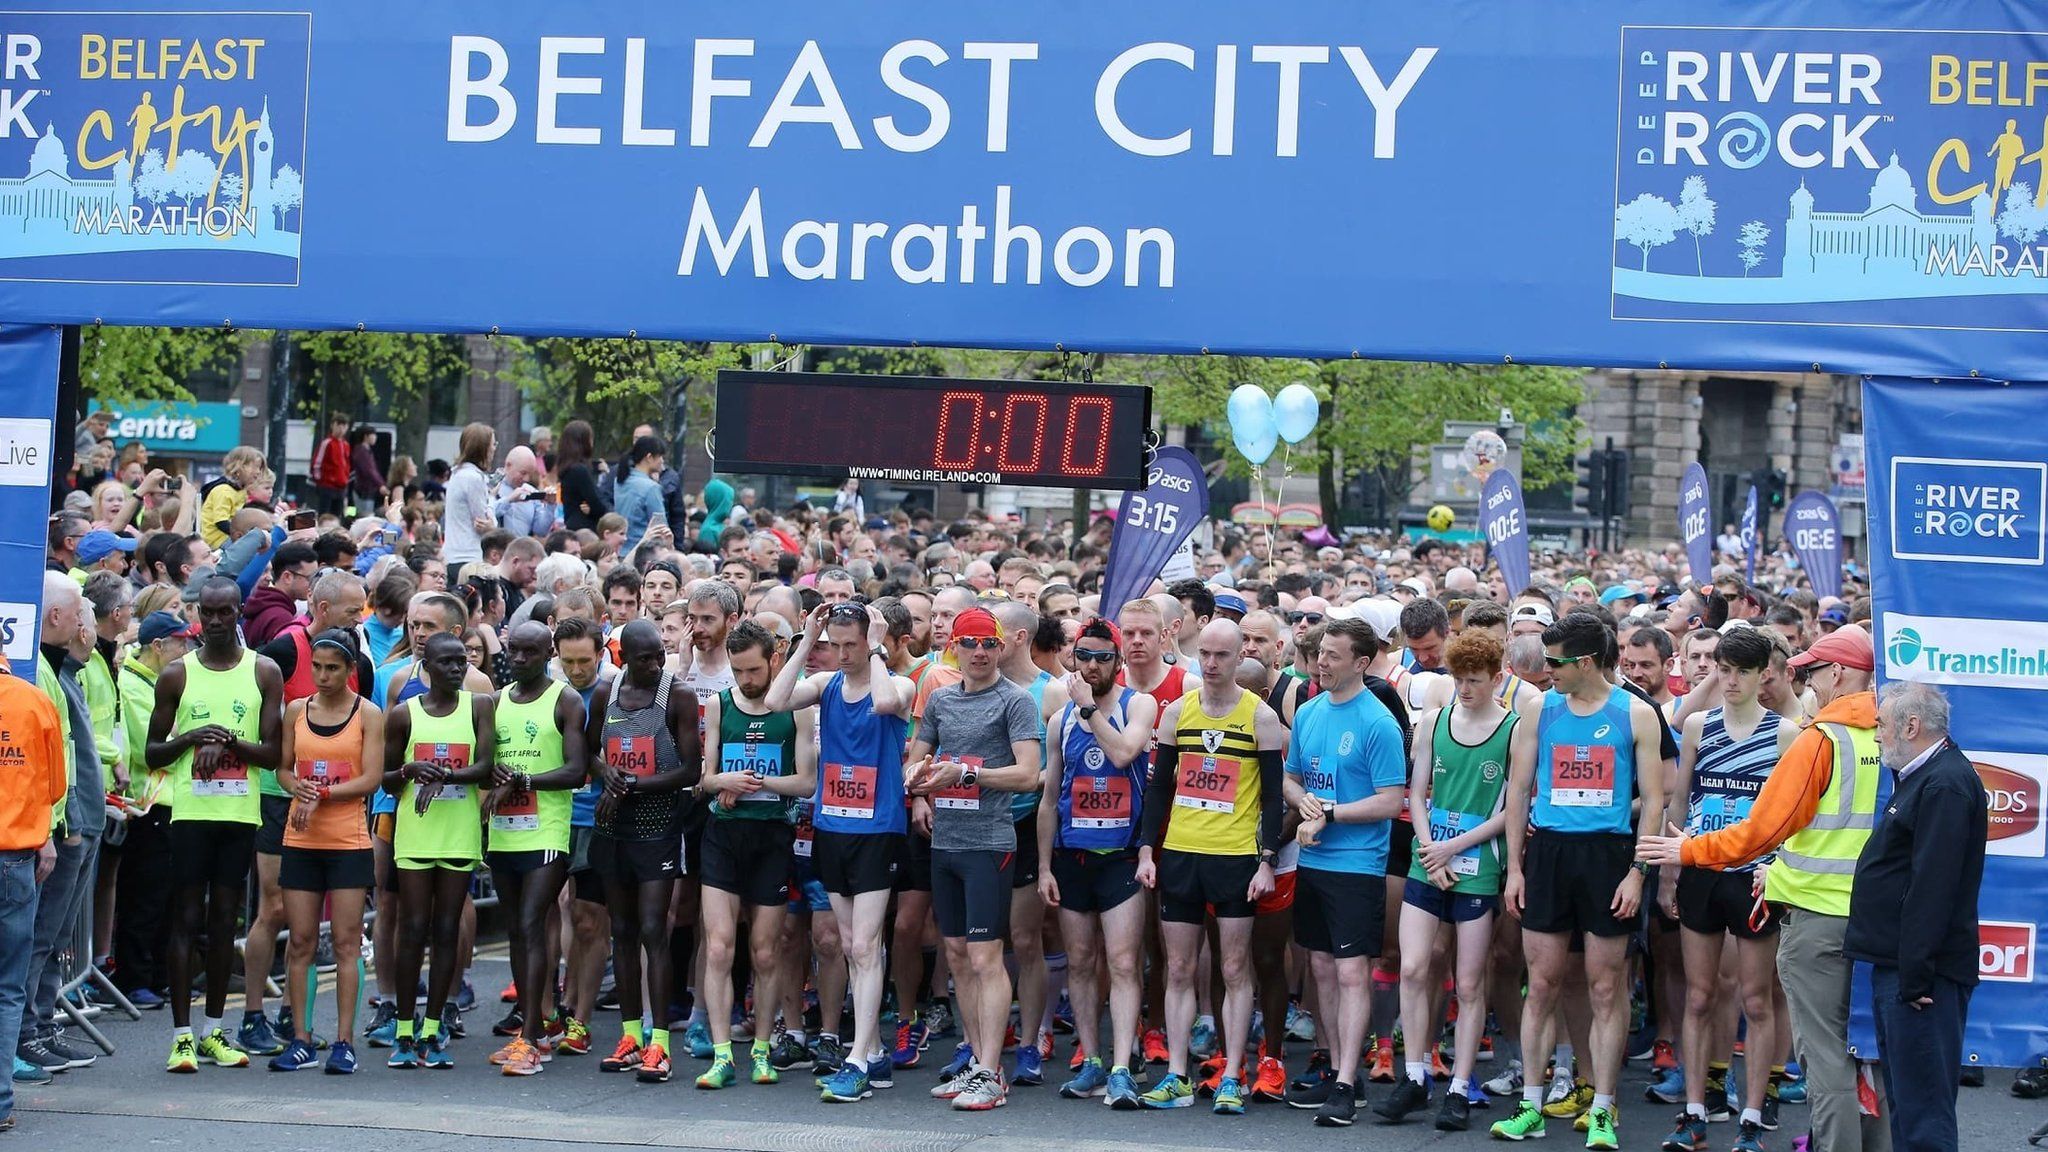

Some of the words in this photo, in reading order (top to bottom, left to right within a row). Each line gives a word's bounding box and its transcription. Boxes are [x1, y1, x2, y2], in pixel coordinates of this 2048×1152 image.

[79, 34, 265, 81] BELFAST
[1665, 50, 1882, 105] RIVER
[1929, 54, 2048, 107] BELF
[445, 35, 1039, 154] BELFAST
[1094, 43, 1440, 160] CITY
[1637, 50, 1658, 165] DEEP
[73, 205, 258, 238] MARATHON
[677, 184, 1176, 289] Marathon
[1914, 483, 1925, 535] DEEP
[1926, 484, 2021, 511] RIVER
[1127, 495, 1180, 534] 3:15
[1923, 647, 2048, 676] Translink
[695, 687, 718, 695] BRISTO
[518, 749, 541, 758] AFRICA
[611, 752, 647, 769] 2464
[724, 759, 779, 776] 7046A
[1184, 770, 1230, 792] 2867
[1559, 761, 1603, 780] 2551
[1726, 778, 1759, 791] VALLEY
[828, 779, 867, 800] 1855
[1078, 791, 1123, 809] 2837
